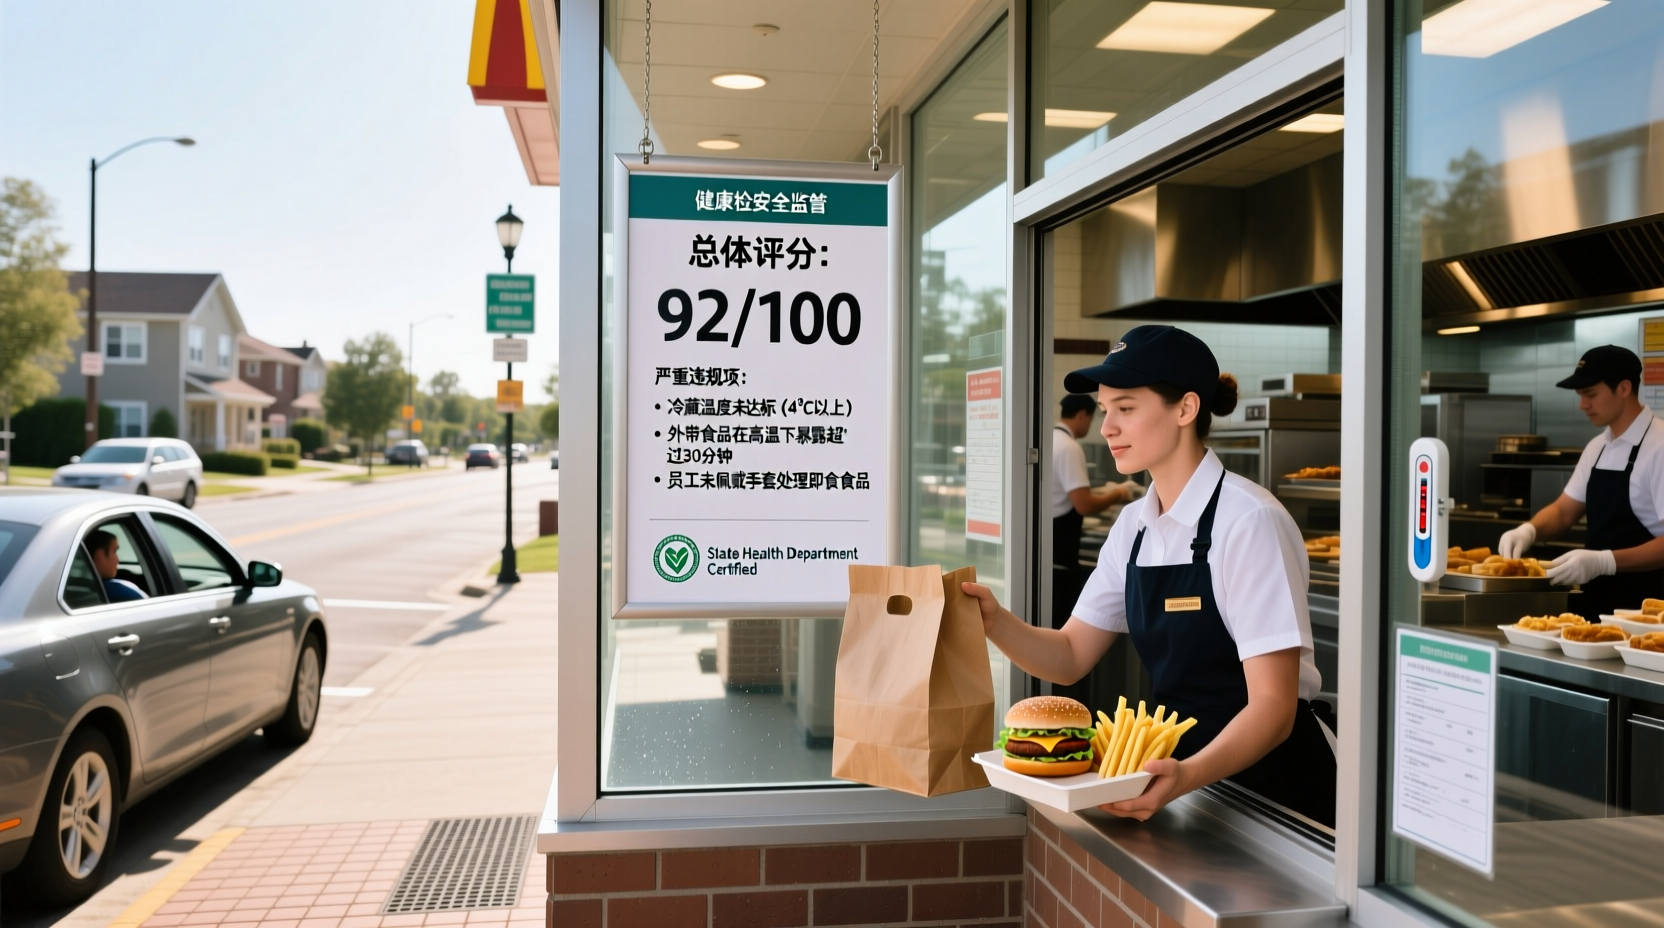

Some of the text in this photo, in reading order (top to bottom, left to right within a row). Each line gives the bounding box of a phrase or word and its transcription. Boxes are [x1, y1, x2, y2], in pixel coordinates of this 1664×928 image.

[695, 189, 828, 215] 健康检安全监管
[688, 233, 829, 271] 总体评分：
[657, 287, 862, 349] 92/100
[666, 446, 733, 465] 过30分钟
[742, 546, 784, 561] Health
[786, 546, 860, 564] Department
